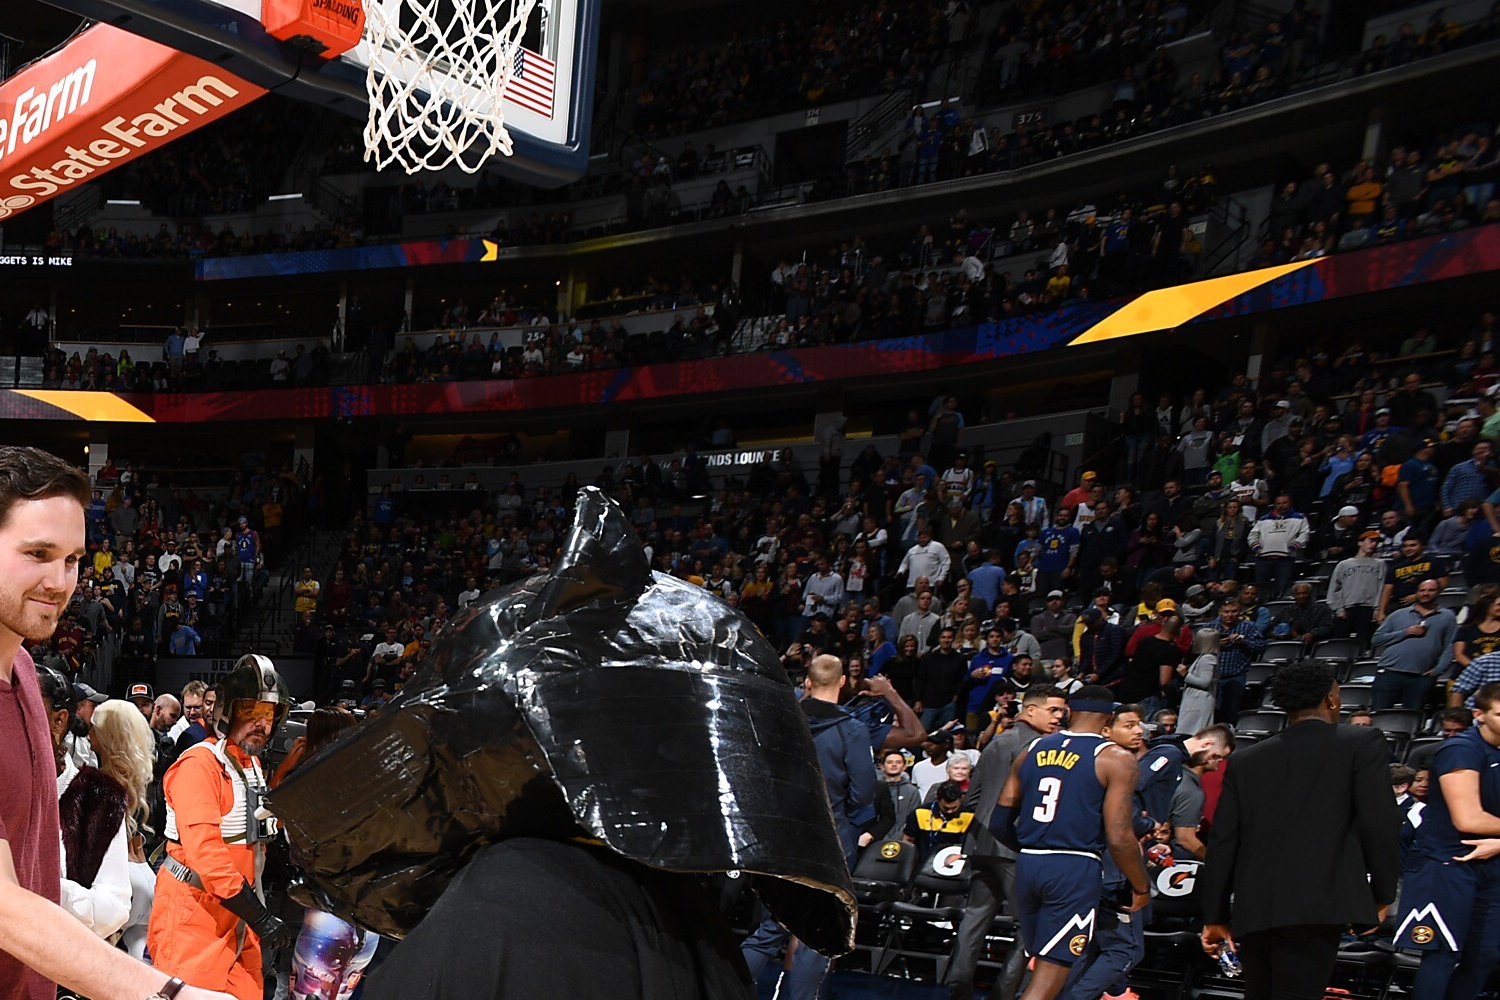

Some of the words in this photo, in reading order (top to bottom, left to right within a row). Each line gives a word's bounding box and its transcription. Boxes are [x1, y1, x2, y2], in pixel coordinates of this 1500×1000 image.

[312, 0, 359, 24] SPALDING
[32, 257, 44, 265] IS
[49, 257, 73, 266] MIKE
[1395, 562, 1431, 578] DENVER
[1036, 750, 1080, 770] CRAIG
[1032, 777, 1062, 823] 3
[933, 846, 966, 876] G
[1157, 864, 1199, 897] G
